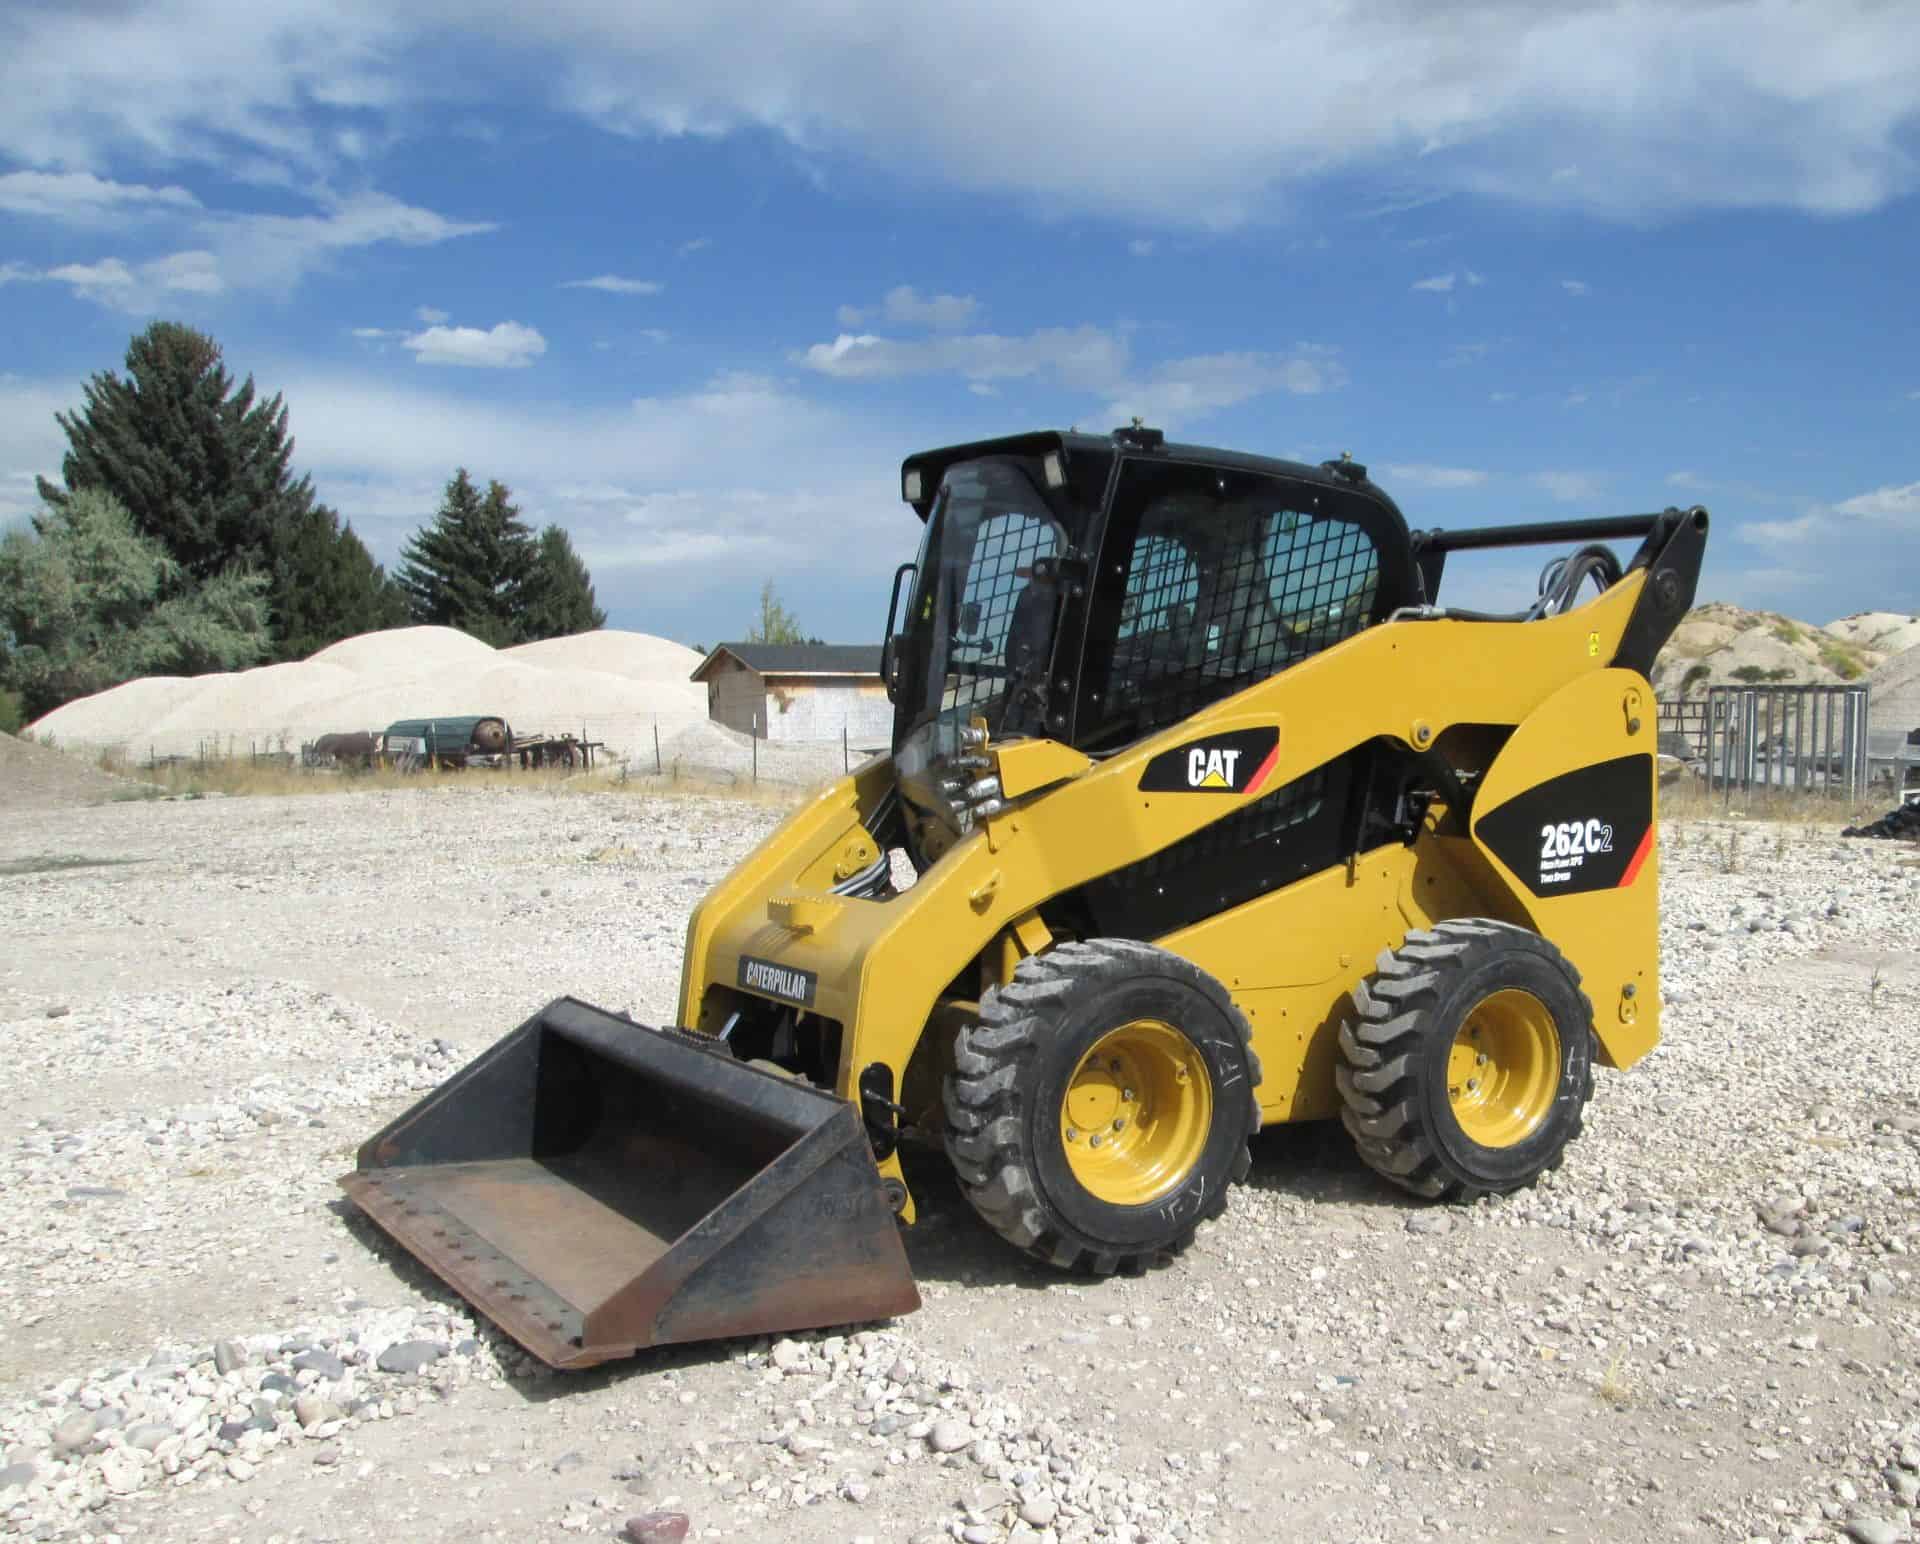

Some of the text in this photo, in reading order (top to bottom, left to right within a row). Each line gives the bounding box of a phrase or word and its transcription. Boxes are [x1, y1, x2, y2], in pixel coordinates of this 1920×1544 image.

[1187, 748, 1238, 788] CAT
[1541, 818, 1613, 859] 262C2
[746, 961, 807, 1001] CATERPILLAR
